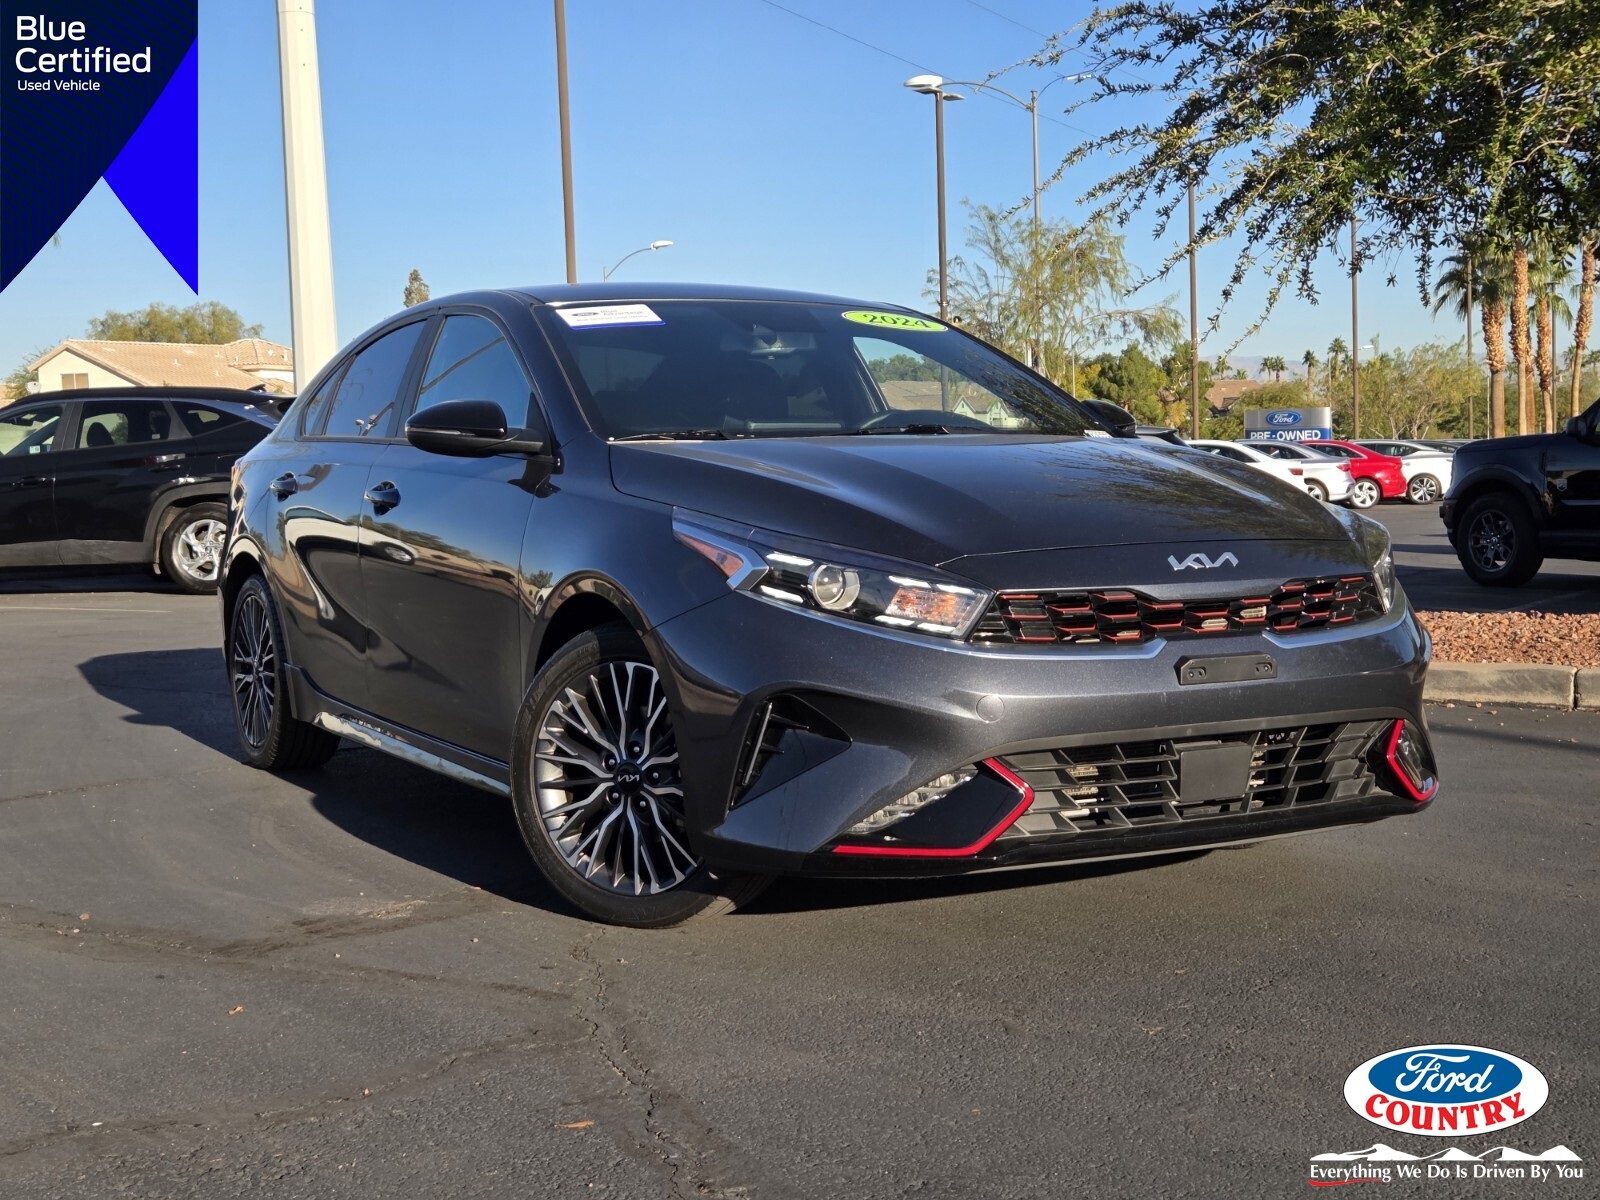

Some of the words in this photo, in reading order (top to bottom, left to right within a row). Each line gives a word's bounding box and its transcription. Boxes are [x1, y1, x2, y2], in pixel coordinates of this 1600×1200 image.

[863, 313, 931, 328] 2024
[1273, 413, 1294, 423] Ford
[1167, 551, 1239, 571] KIA
